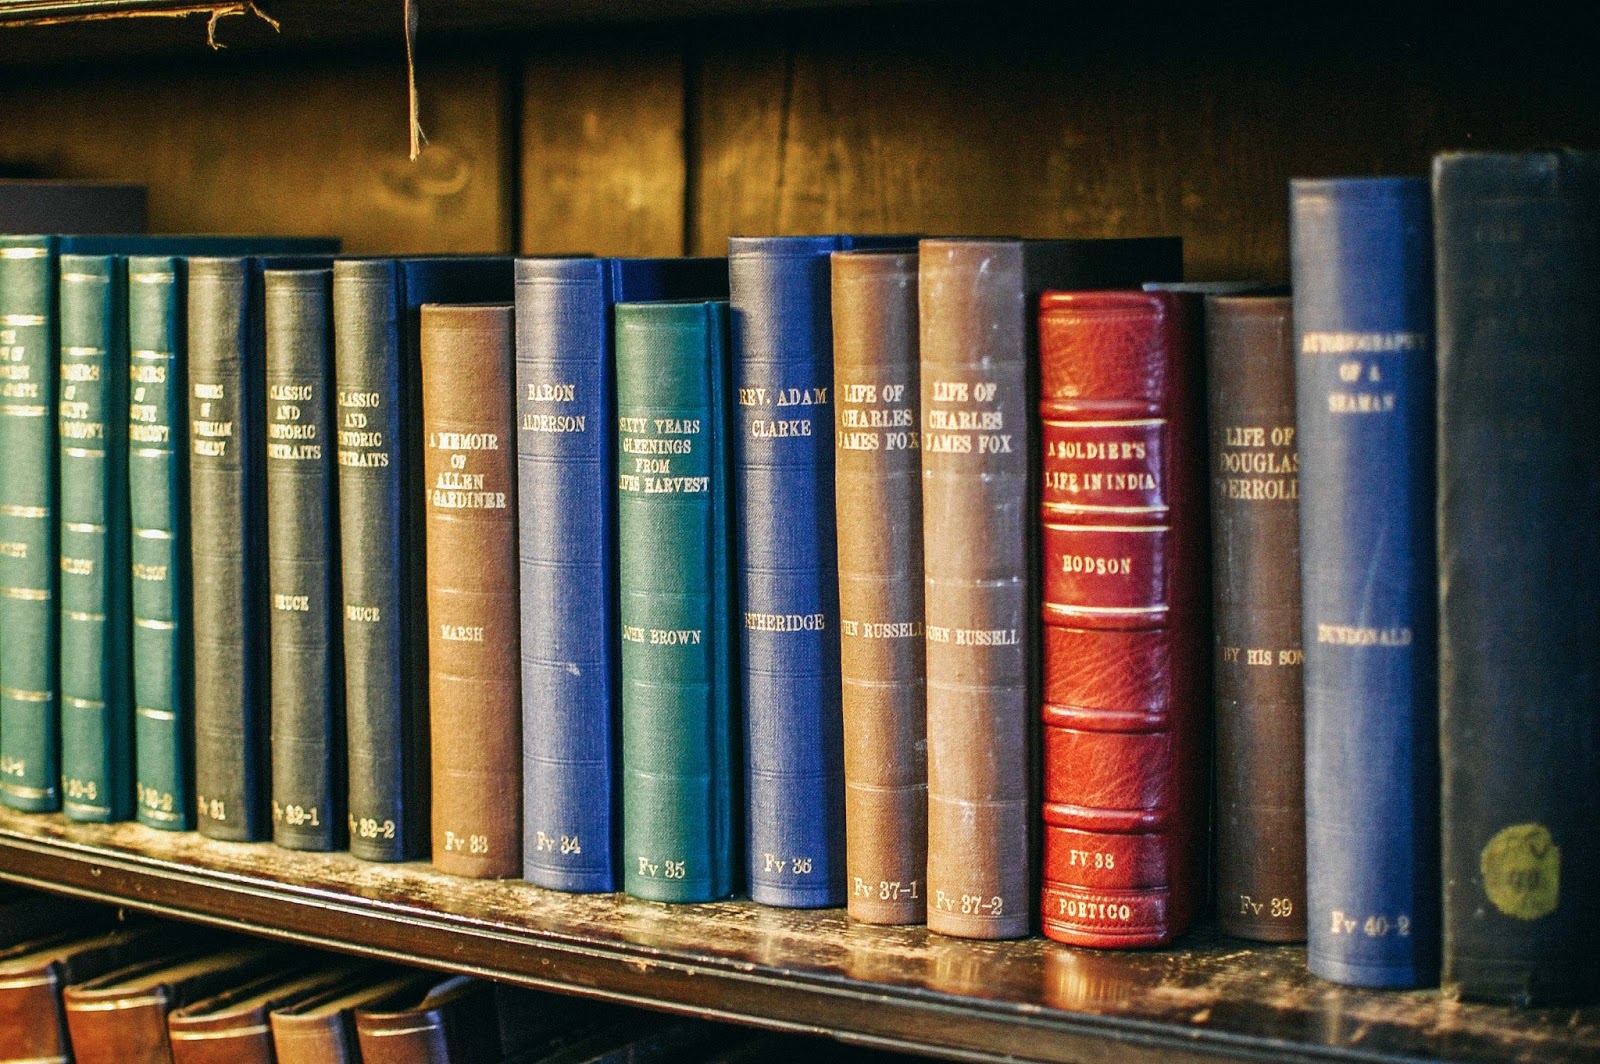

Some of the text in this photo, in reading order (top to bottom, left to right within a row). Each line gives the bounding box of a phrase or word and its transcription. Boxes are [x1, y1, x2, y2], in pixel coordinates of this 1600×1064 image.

[527, 383, 576, 402] BARON
[739, 387, 828, 406] REV. ADAM
[844, 384, 905, 403] LIFE OF
[933, 382, 997, 402] LIFE OF
[276, 404, 301, 420] AND
[842, 408, 914, 428] CHARLES
[928, 410, 1004, 430] CHARLES
[522, 413, 586, 433] ALDERSON
[653, 419, 701, 434] YEARS
[751, 419, 812, 438] CLARKE
[438, 432, 499, 451] MEMOIR
[838, 431, 920, 451] JAMES FOX
[925, 433, 1012, 454] JAMES FOX
[1225, 427, 1295, 447] LIFE OF
[1057, 441, 1146, 460] SOLDIER'S
[450, 453, 467, 470] OF
[635, 457, 671, 474] FROM
[435, 472, 485, 491] ALLEN
[644, 476, 709, 494] HARVEST
[1045, 471, 1157, 493] LIFE IN INDIA
[1220, 479, 1299, 500] ERROL
[433, 490, 507, 509] GARDINER
[1062, 554, 1132, 575] HODSON
[744, 612, 826, 632] ETHERIDGE
[862, 621, 924, 639] RUSSELL
[440, 624, 484, 642] MARSH
[650, 629, 702, 645] BROWN
[956, 628, 1020, 646] RUSSELL
[1247, 649, 1272, 666] HIS
[536, 831, 581, 855] Fv 34
[637, 856, 686, 879] Fv 35
[763, 853, 786, 874] Fv
[1070, 849, 1115, 870] FV 38
[853, 876, 919, 900] Fv 37-1
[935, 890, 1004, 916] Fv 37-2
[1059, 898, 1131, 920] PORTICO
[1240, 895, 1293, 917] Fv 39
